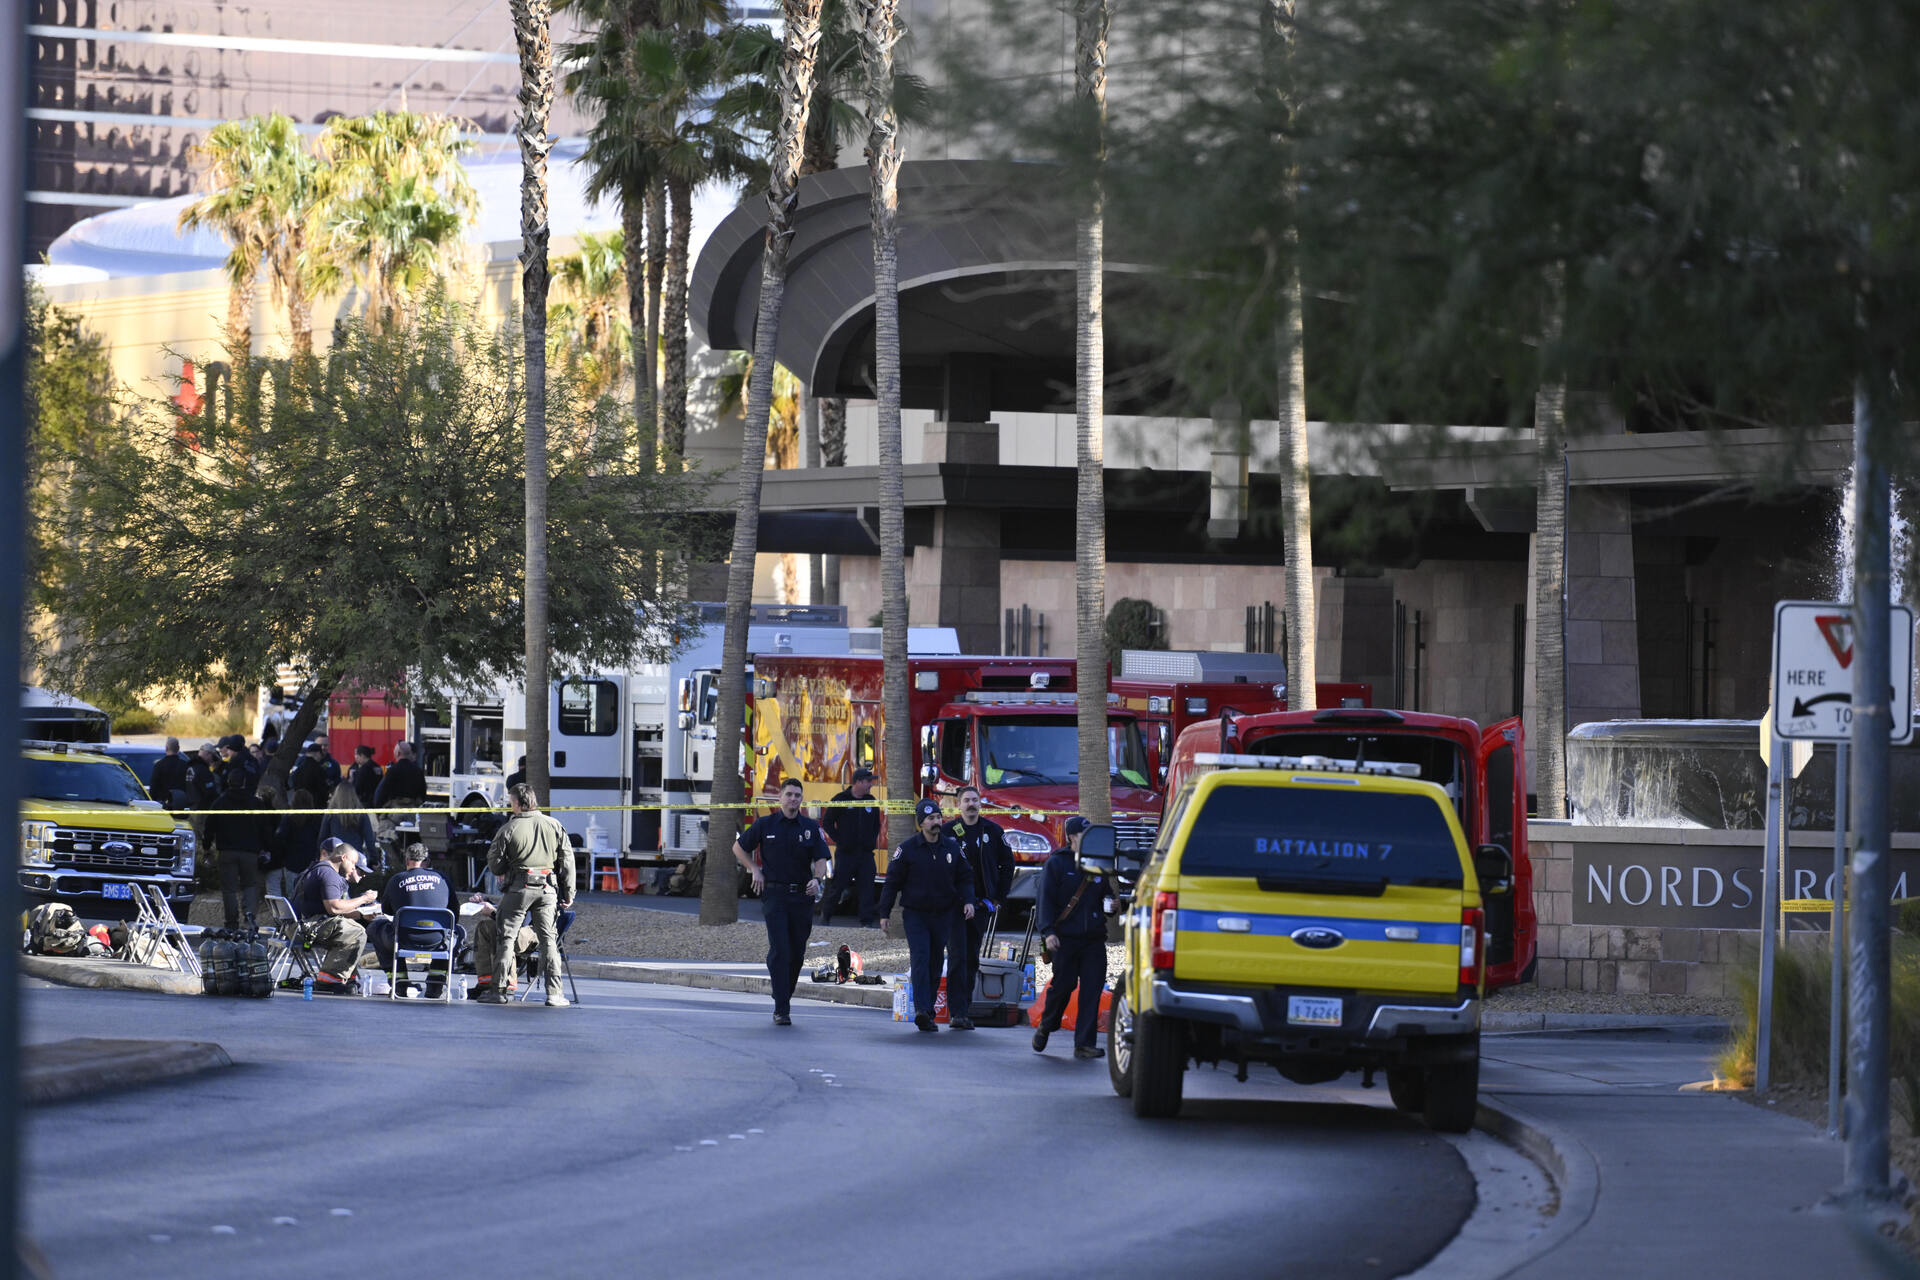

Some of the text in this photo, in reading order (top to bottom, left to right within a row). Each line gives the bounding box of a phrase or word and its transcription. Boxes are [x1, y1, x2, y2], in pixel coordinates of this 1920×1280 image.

[1786, 670, 1826, 686] HERE
[780, 678, 847, 697] LAS VEGAS
[813, 705, 847, 720] RESCUE
[1834, 707, 1853, 723] TO
[1255, 837, 1393, 860] BATTALION 7
[399, 875, 440, 888] CLARK COUNTY
[406, 884, 418, 892] FIRE
[1587, 863, 1908, 909] NORDSRM
[103, 884, 119, 898] EMS
